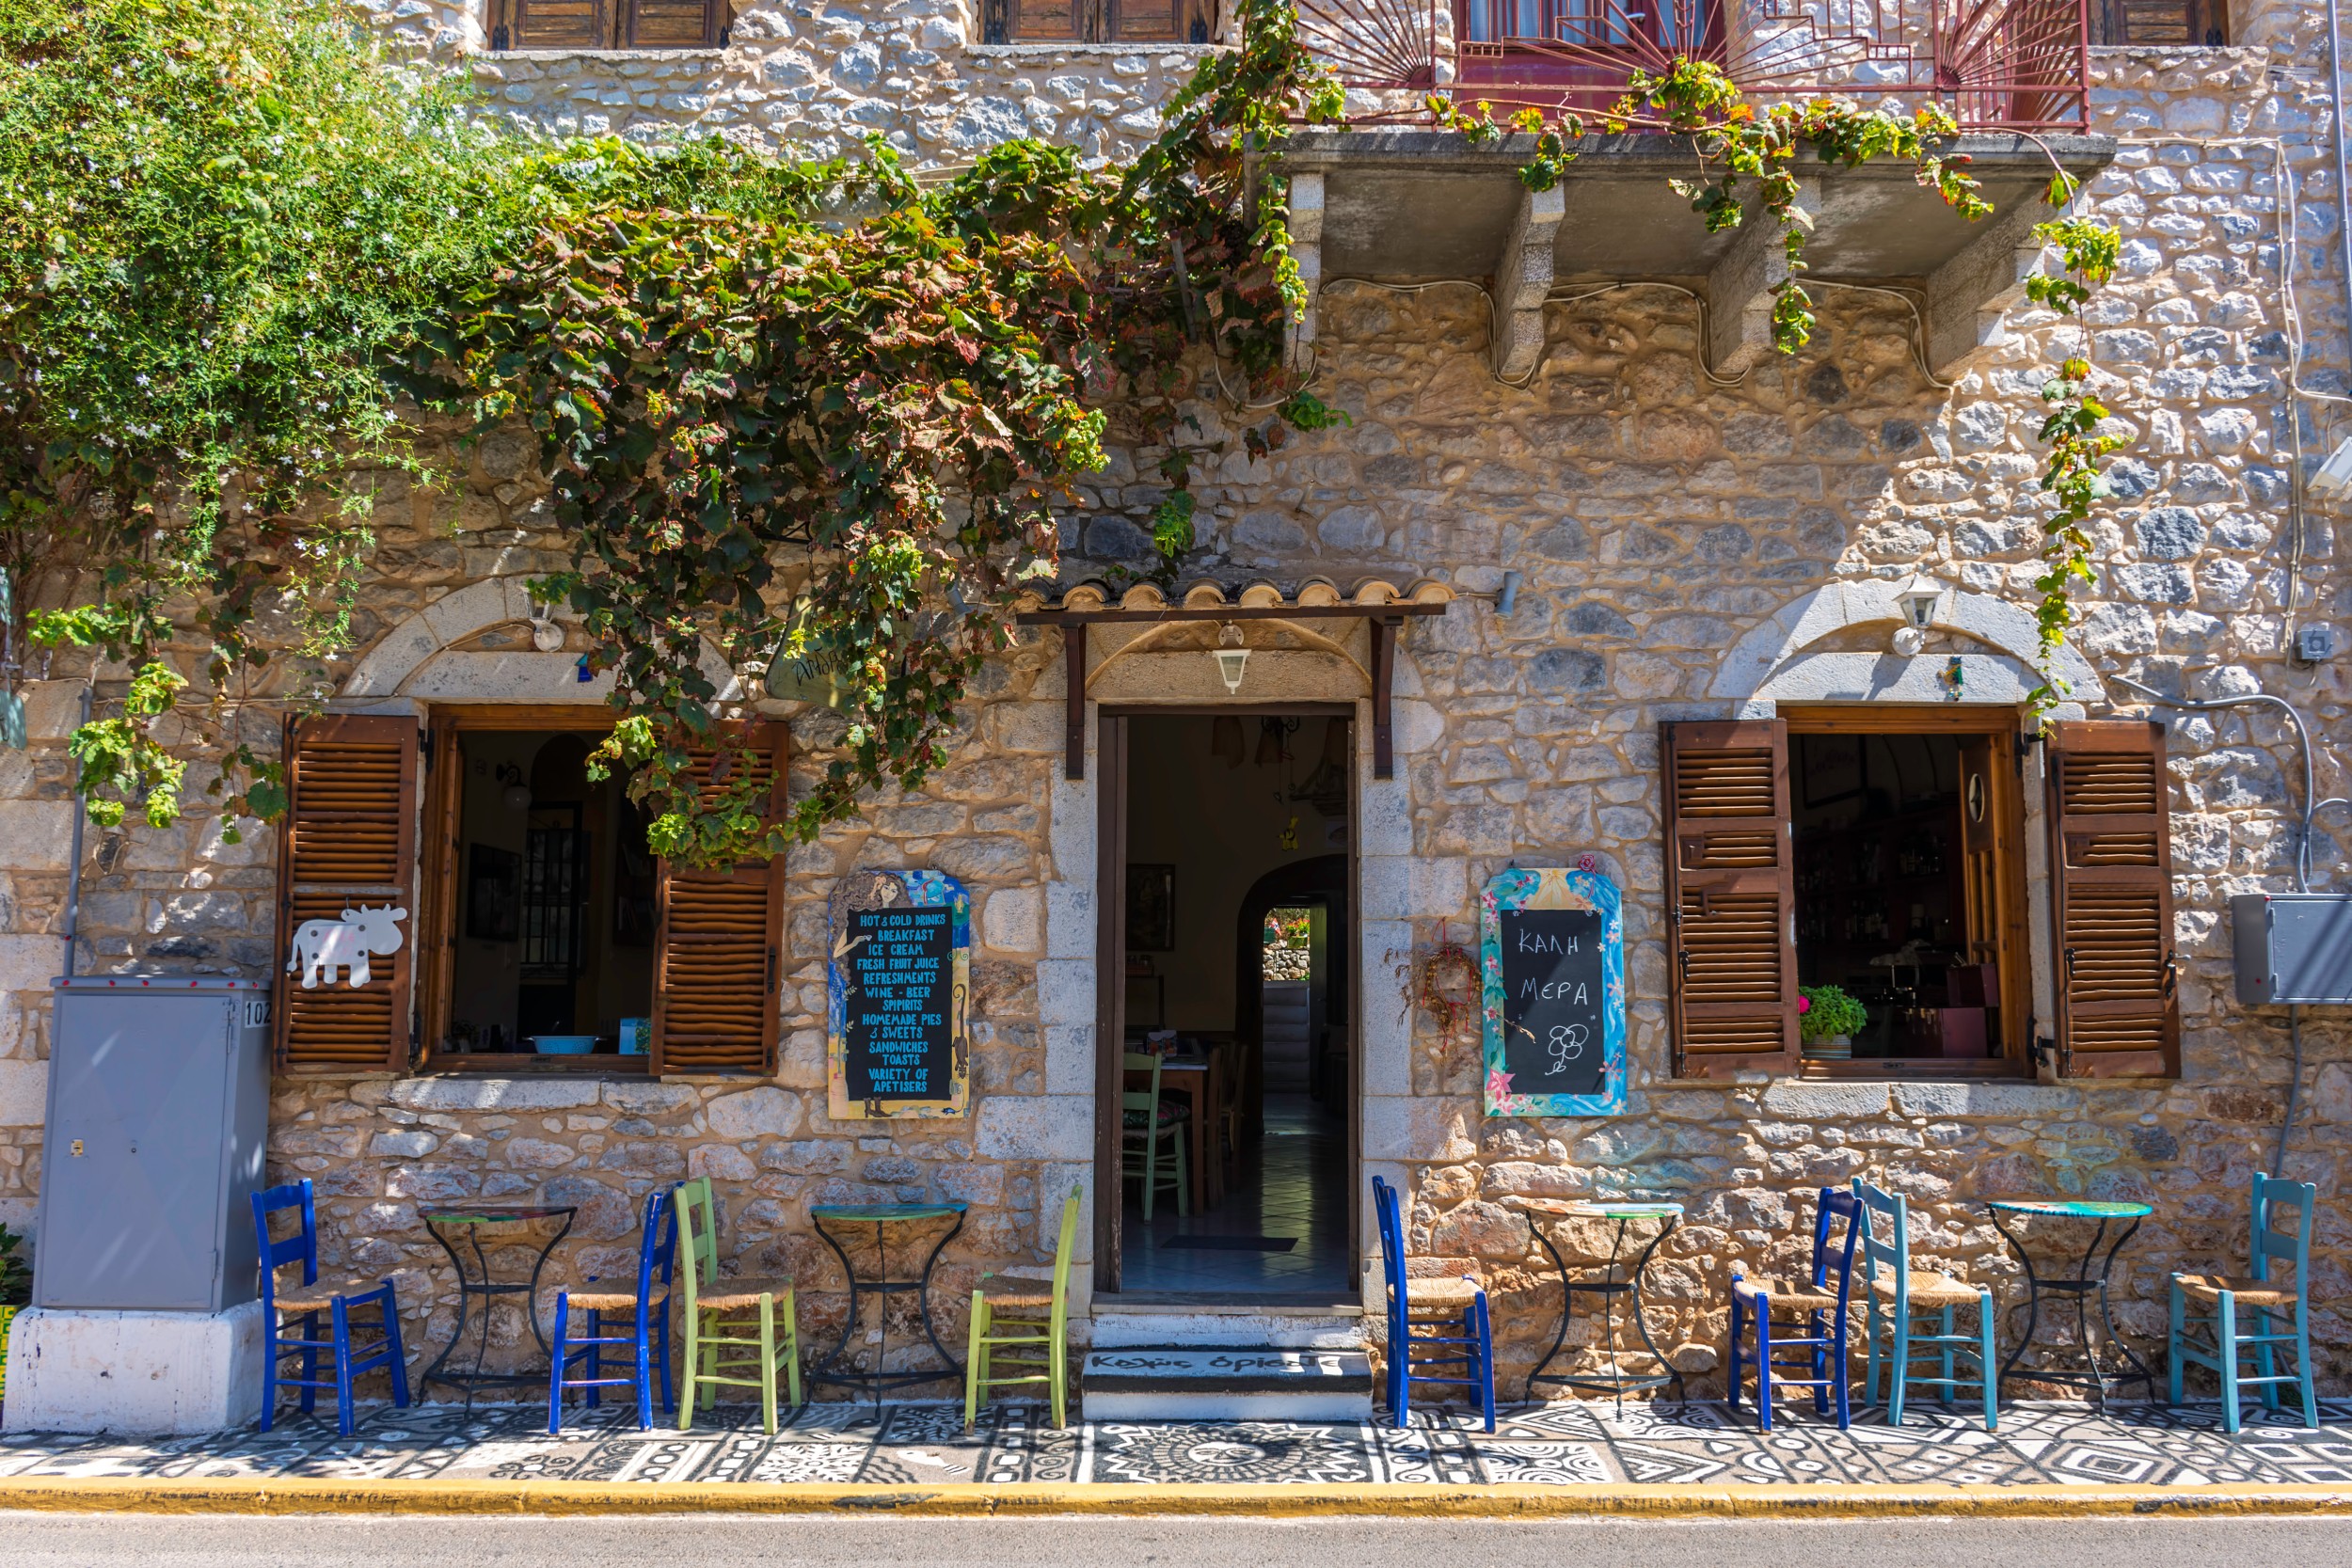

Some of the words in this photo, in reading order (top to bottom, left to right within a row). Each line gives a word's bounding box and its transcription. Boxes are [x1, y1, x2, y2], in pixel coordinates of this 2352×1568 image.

[860, 915, 880, 927] HOT
[889, 915, 913, 927] COLD
[915, 914, 946, 926] DRINKS
[878, 929, 935, 942] BREAKFAST
[868, 944, 883, 956] ICE
[890, 943, 924, 956] CREAM
[857, 958, 884, 970] FRESH
[889, 958, 913, 970] FRUIT
[914, 958, 940, 970] JUICE
[864, 972, 937, 985] REFRESHMENTS
[866, 987, 893, 998] WINE
[906, 987, 930, 998] BEER
[882, 999, 923, 1011] SPIPIRITS
[247, 1002, 272, 1025] 102
[862, 1014, 916, 1025] HOMEMADE
[921, 1013, 942, 1025] PIES
[882, 1026, 923, 1038] SWEETS
[869, 1041, 929, 1053] SANDWICHES
[882, 1053, 920, 1066] TOASTS
[868, 1069, 910, 1080] VARIETY
[915, 1069, 929, 1080] OF
[873, 1081, 927, 1092] APETISERS
